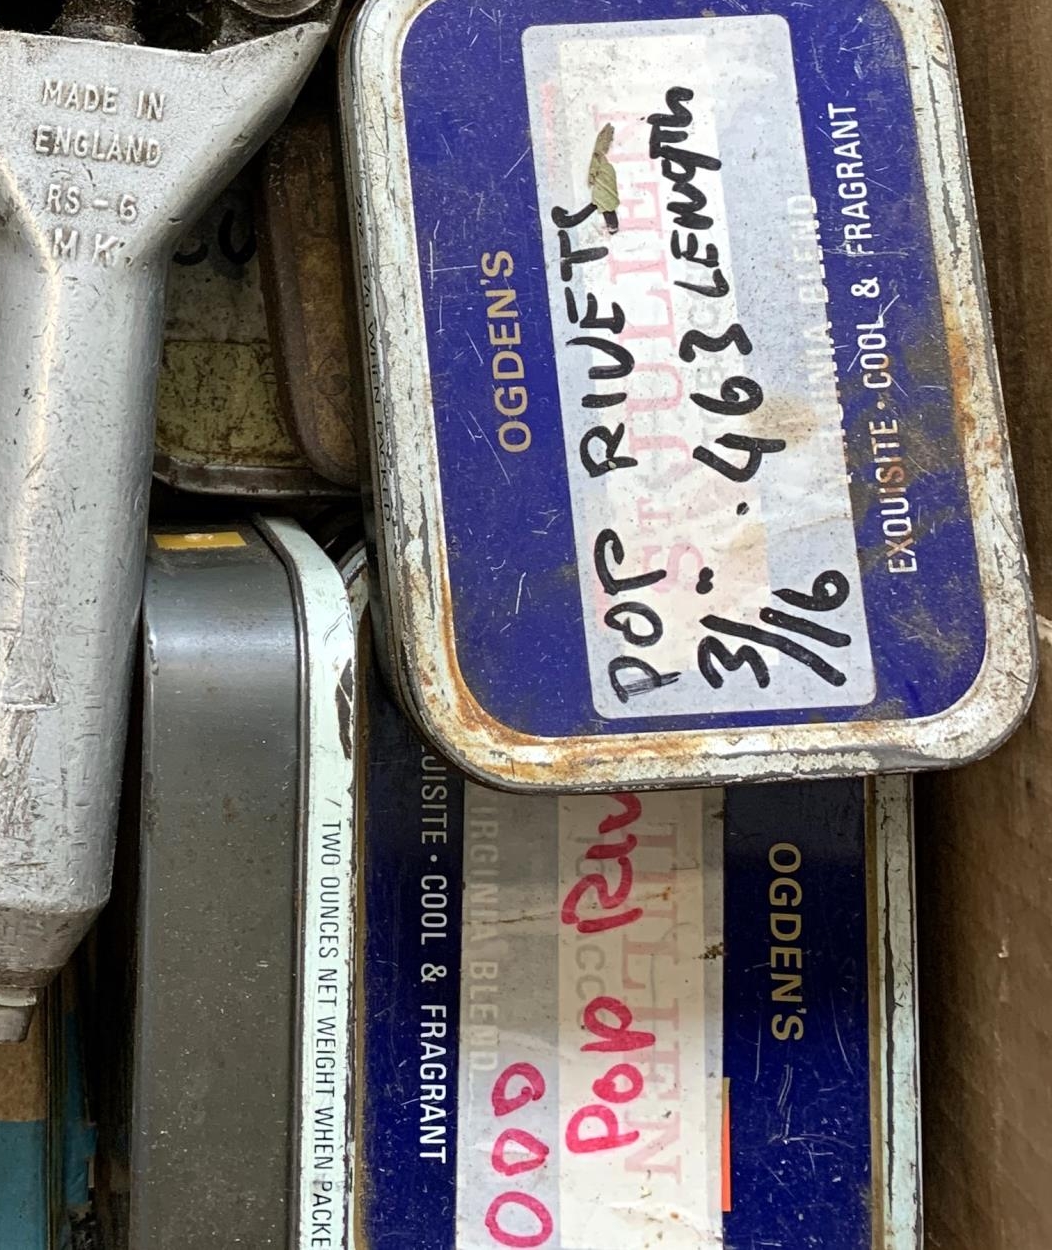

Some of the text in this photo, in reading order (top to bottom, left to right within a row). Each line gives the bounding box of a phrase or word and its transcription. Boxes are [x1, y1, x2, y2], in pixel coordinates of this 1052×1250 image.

[33, 123, 164, 169] ENGLAND
[40, 78, 166, 122] MADE IN
[479, 248, 533, 454] OGDEN'S
[826, 101, 918, 574] EXQUISITE COOL & FRAGRANT
[595, 528, 681, 705] POP
[420, 874, 449, 946] COOL
[468, 805, 500, 944] IRGINIA
[767, 840, 808, 1043] OGDEN'S
[310, 819, 342, 1249] TWO OUNCES NET WEIGHT WHEN PACKE
[420, 962, 449, 985] &
[417, 1003, 449, 1166] FRAGRANT
